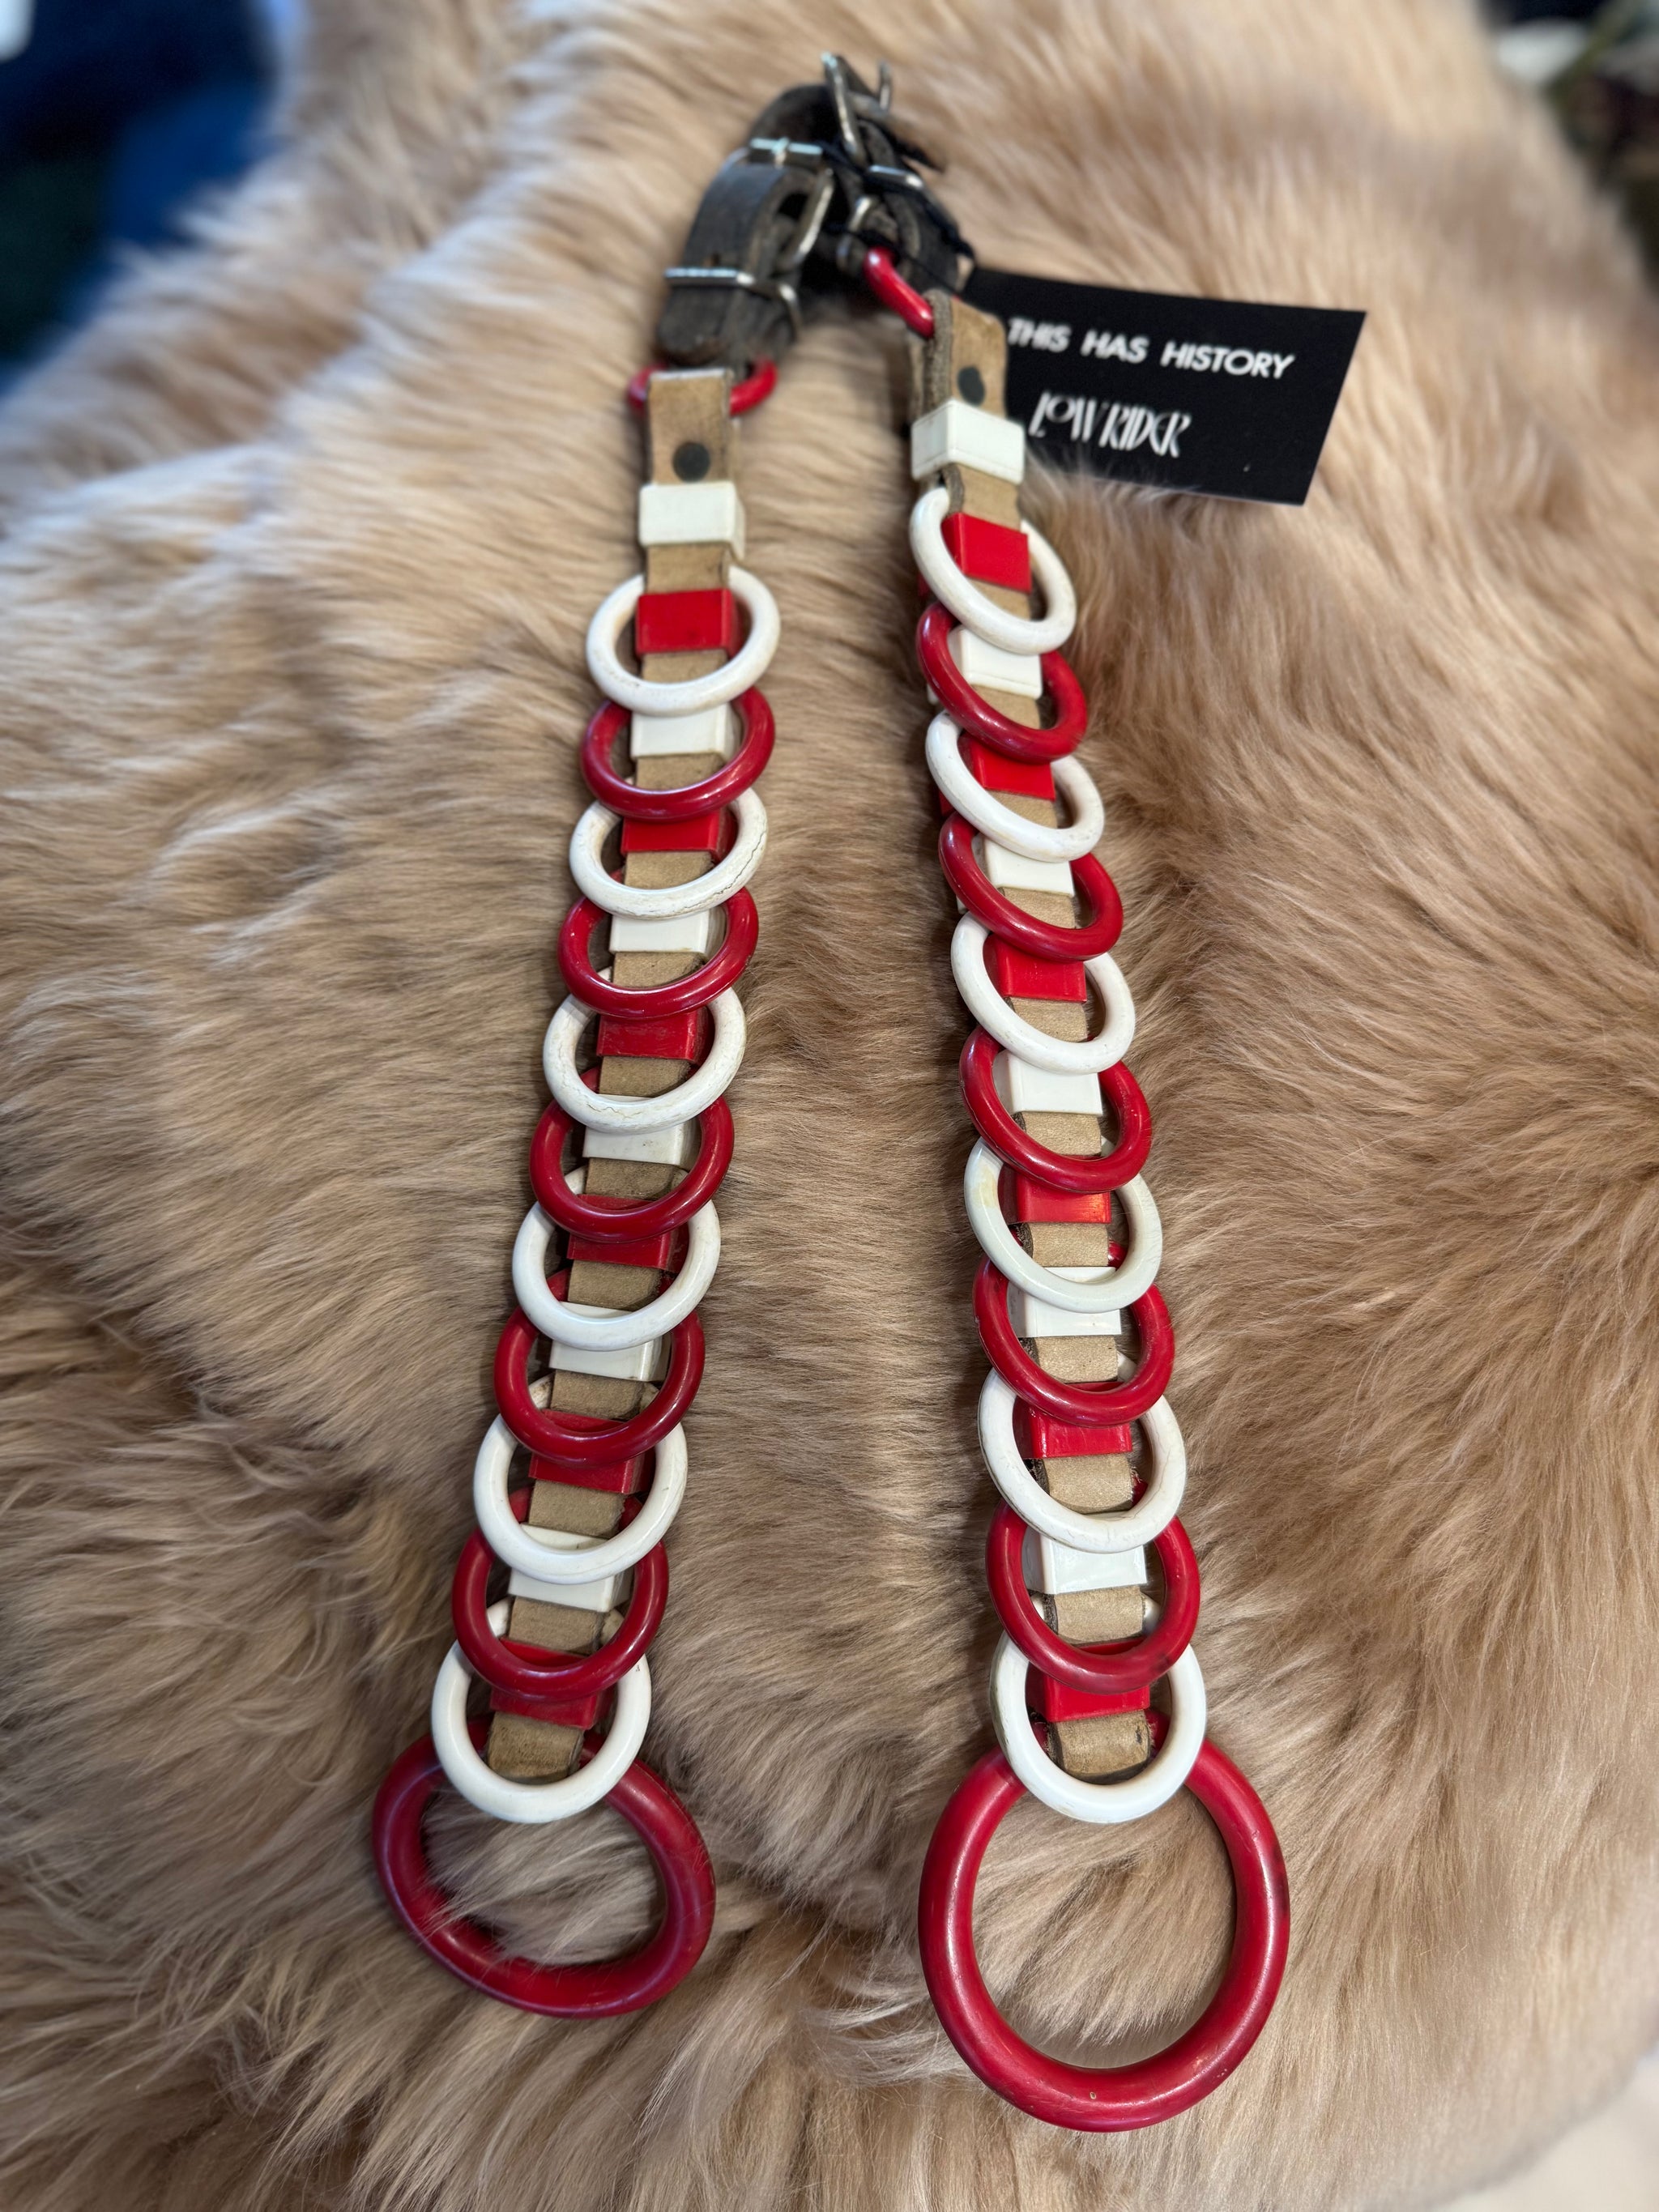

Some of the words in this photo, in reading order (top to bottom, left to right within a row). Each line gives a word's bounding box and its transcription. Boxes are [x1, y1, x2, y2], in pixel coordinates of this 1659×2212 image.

[1008, 318, 1071, 352] THIS
[1081, 330, 1149, 364] HAS
[1161, 342, 1294, 378] HISTORY
